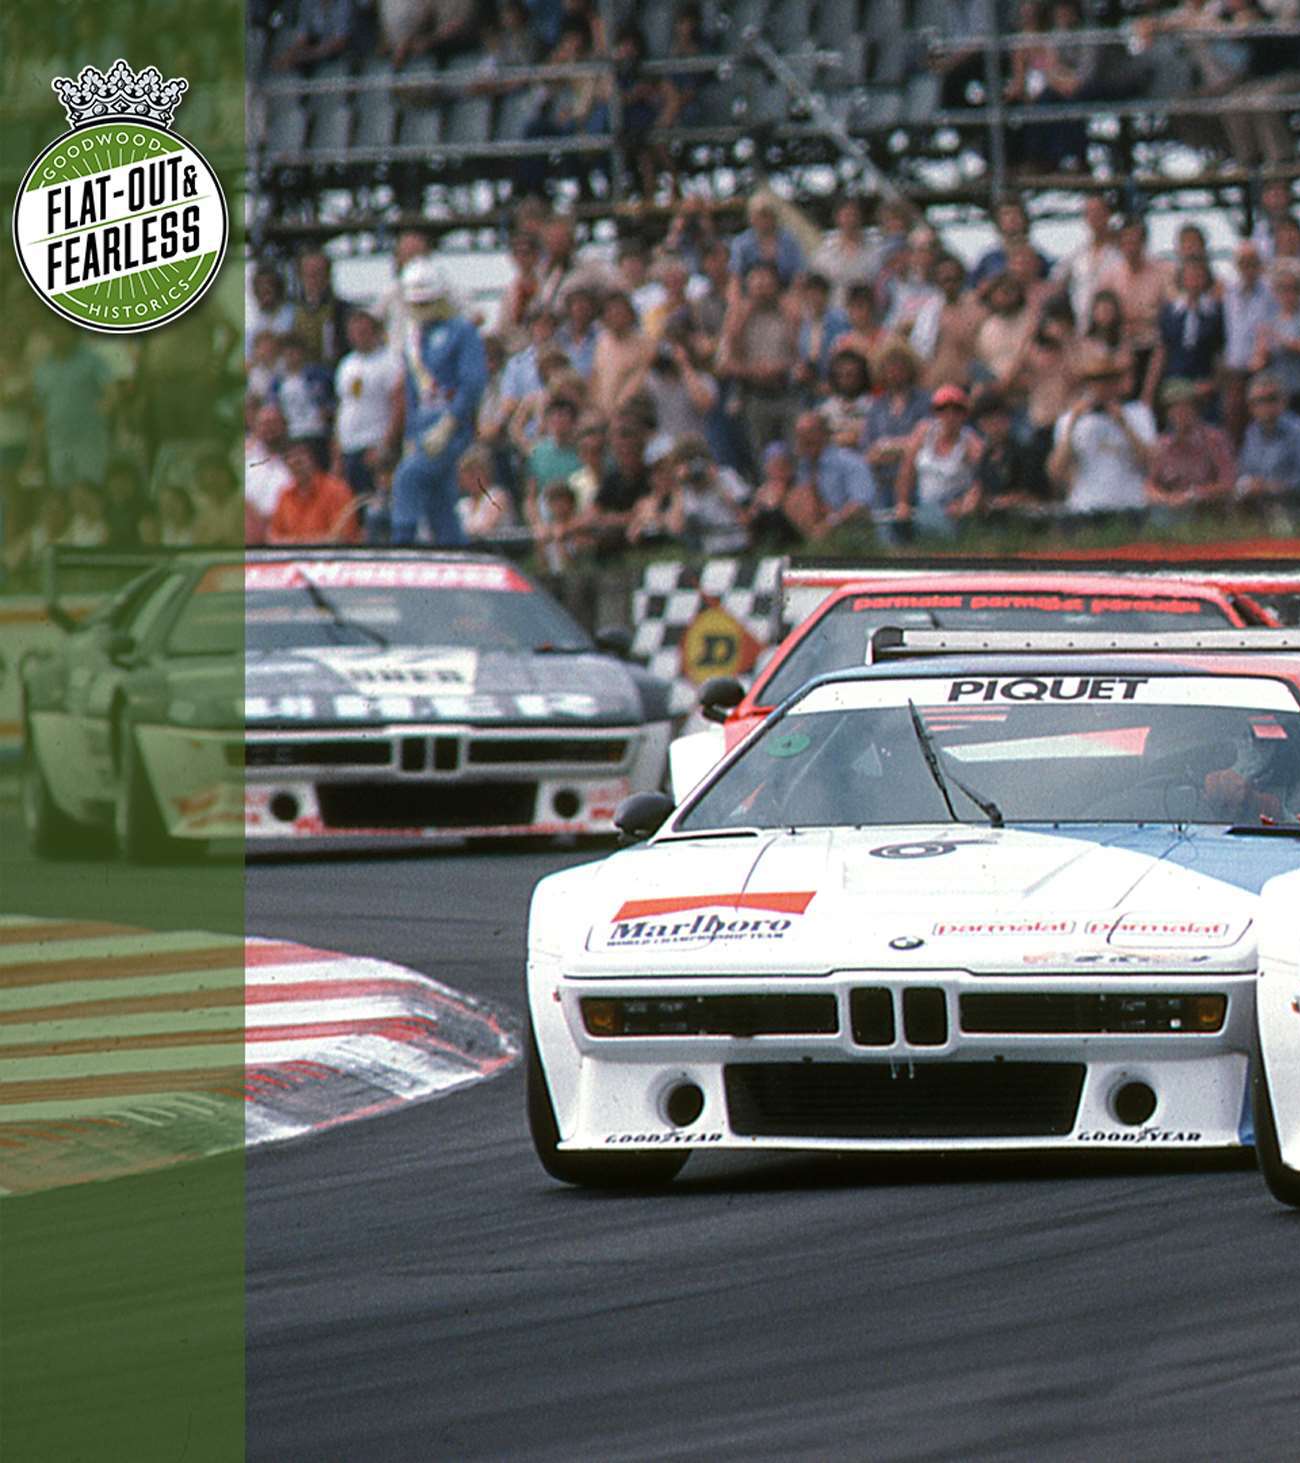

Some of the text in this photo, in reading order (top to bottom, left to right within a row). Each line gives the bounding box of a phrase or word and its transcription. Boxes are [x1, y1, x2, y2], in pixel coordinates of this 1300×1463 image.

[696, 635, 737, 666] D
[948, 679, 1149, 702] PIQUET
[869, 838, 998, 859] 6
[611, 915, 791, 940] Marlboro
